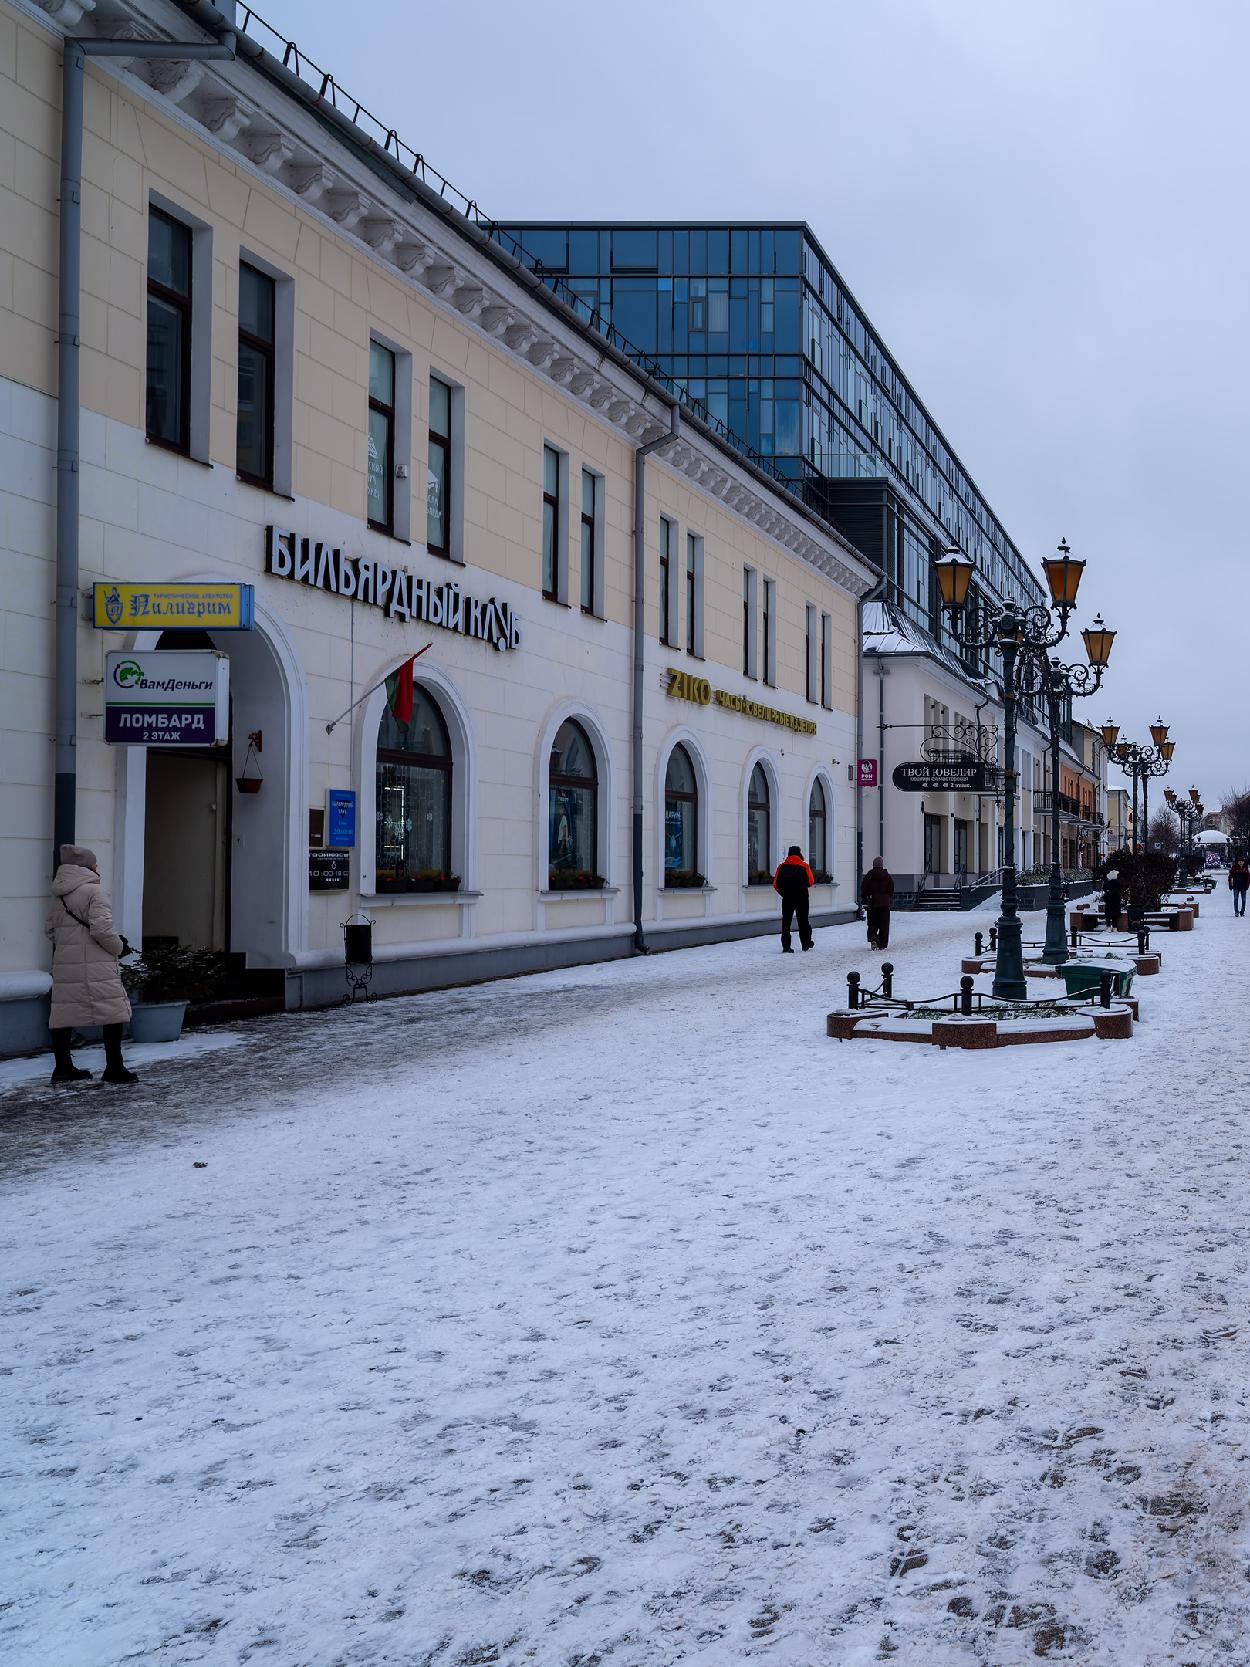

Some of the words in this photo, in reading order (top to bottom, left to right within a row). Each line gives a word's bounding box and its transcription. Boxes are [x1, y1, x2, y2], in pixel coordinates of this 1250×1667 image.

[268, 526, 463, 623] БИЛЬЯРДНЫЙ
[466, 597, 522, 652] КЛУБ
[129, 593, 232, 618] Пилигрим
[139, 678, 213, 692] ВамДеньги
[667, 667, 712, 705] ZIKO
[716, 690, 743, 713] ЧАСЫ
[745, 700, 790, 727] ЮВЕЛИРНЫЕ
[790, 715, 817, 735] ИЗДЕЛИЯ
[119, 713, 205, 730] ЛОМБАРД
[143, 731, 149, 740] 2
[151, 731, 181, 740] ЭТАЖ
[901, 766, 930, 777] ТВОЙ
[932, 767, 977, 777] ЮВЕЛИР
